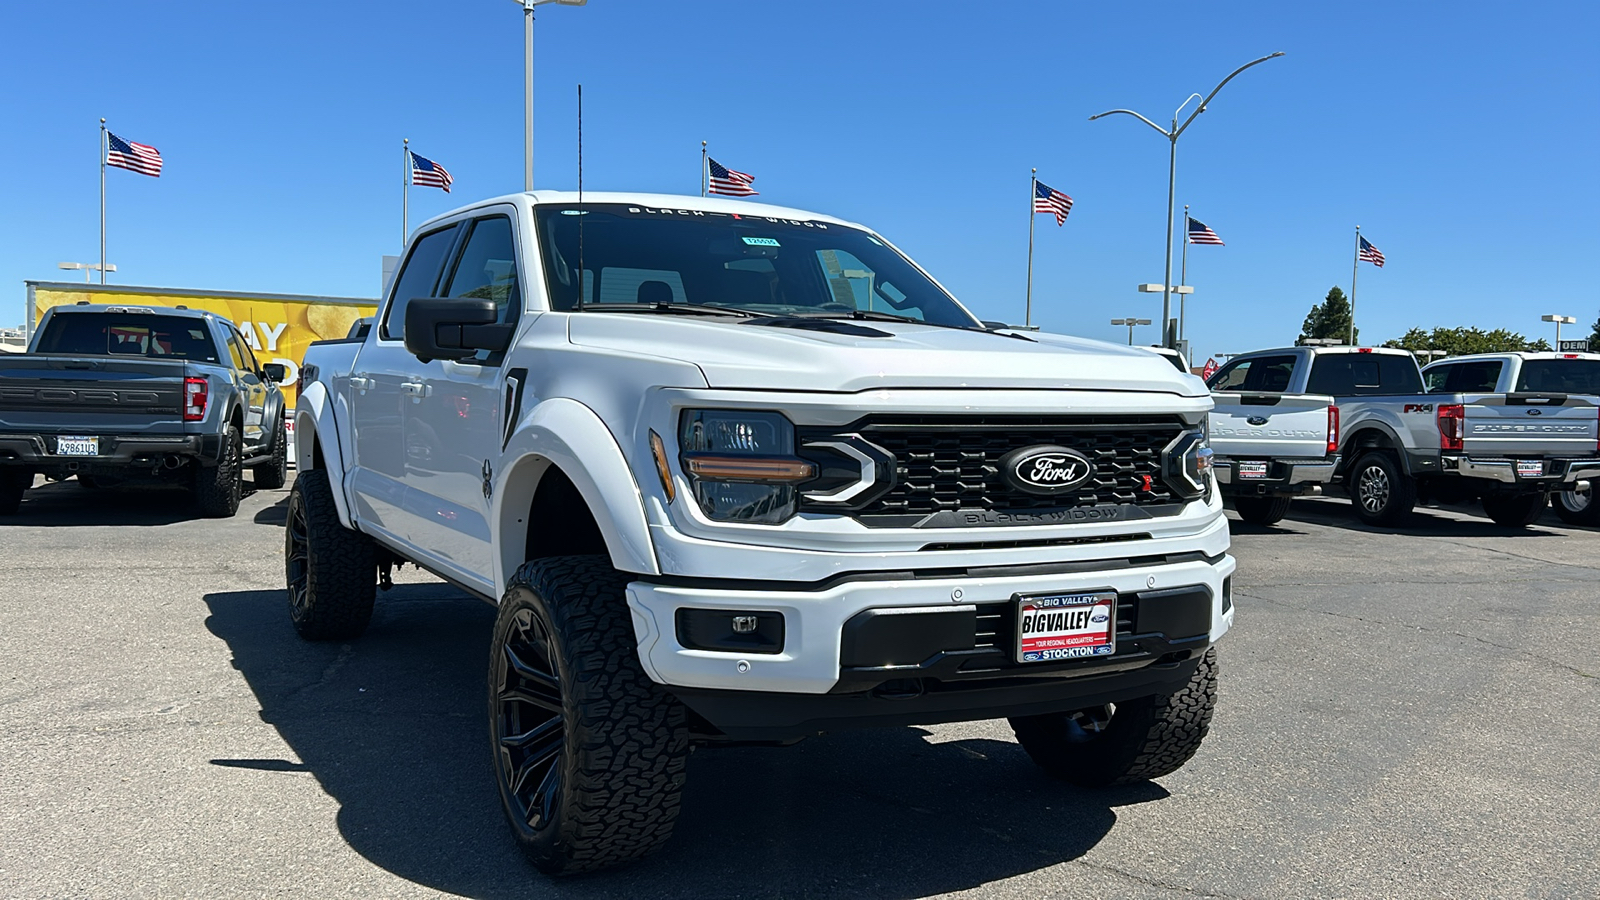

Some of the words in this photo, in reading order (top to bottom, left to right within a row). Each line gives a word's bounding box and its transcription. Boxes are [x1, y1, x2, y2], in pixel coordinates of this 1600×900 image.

[628, 207, 705, 217] BLACK
[765, 217, 828, 230] WIDOW
[239, 321, 288, 351] AY
[1562, 341, 1586, 350] OEM
[1404, 404, 1433, 413] FX4
[1209, 428, 1263, 437] UPER
[1268, 430, 1321, 438] DUTY
[1030, 457, 1077, 481] Ford
[965, 512, 1043, 524] BLACK
[1050, 508, 1118, 521] WIDOW
[1044, 599, 1060, 607] BIG
[1062, 596, 1093, 604] VALLEY
[1023, 610, 1092, 633] BIGVALLEY
[1035, 640, 1047, 648] YOUR
[1047, 638, 1066, 646] REGIONAL
[1066, 636, 1094, 645] HEADQUARTERS
[1042, 646, 1094, 659] STOCKTON
